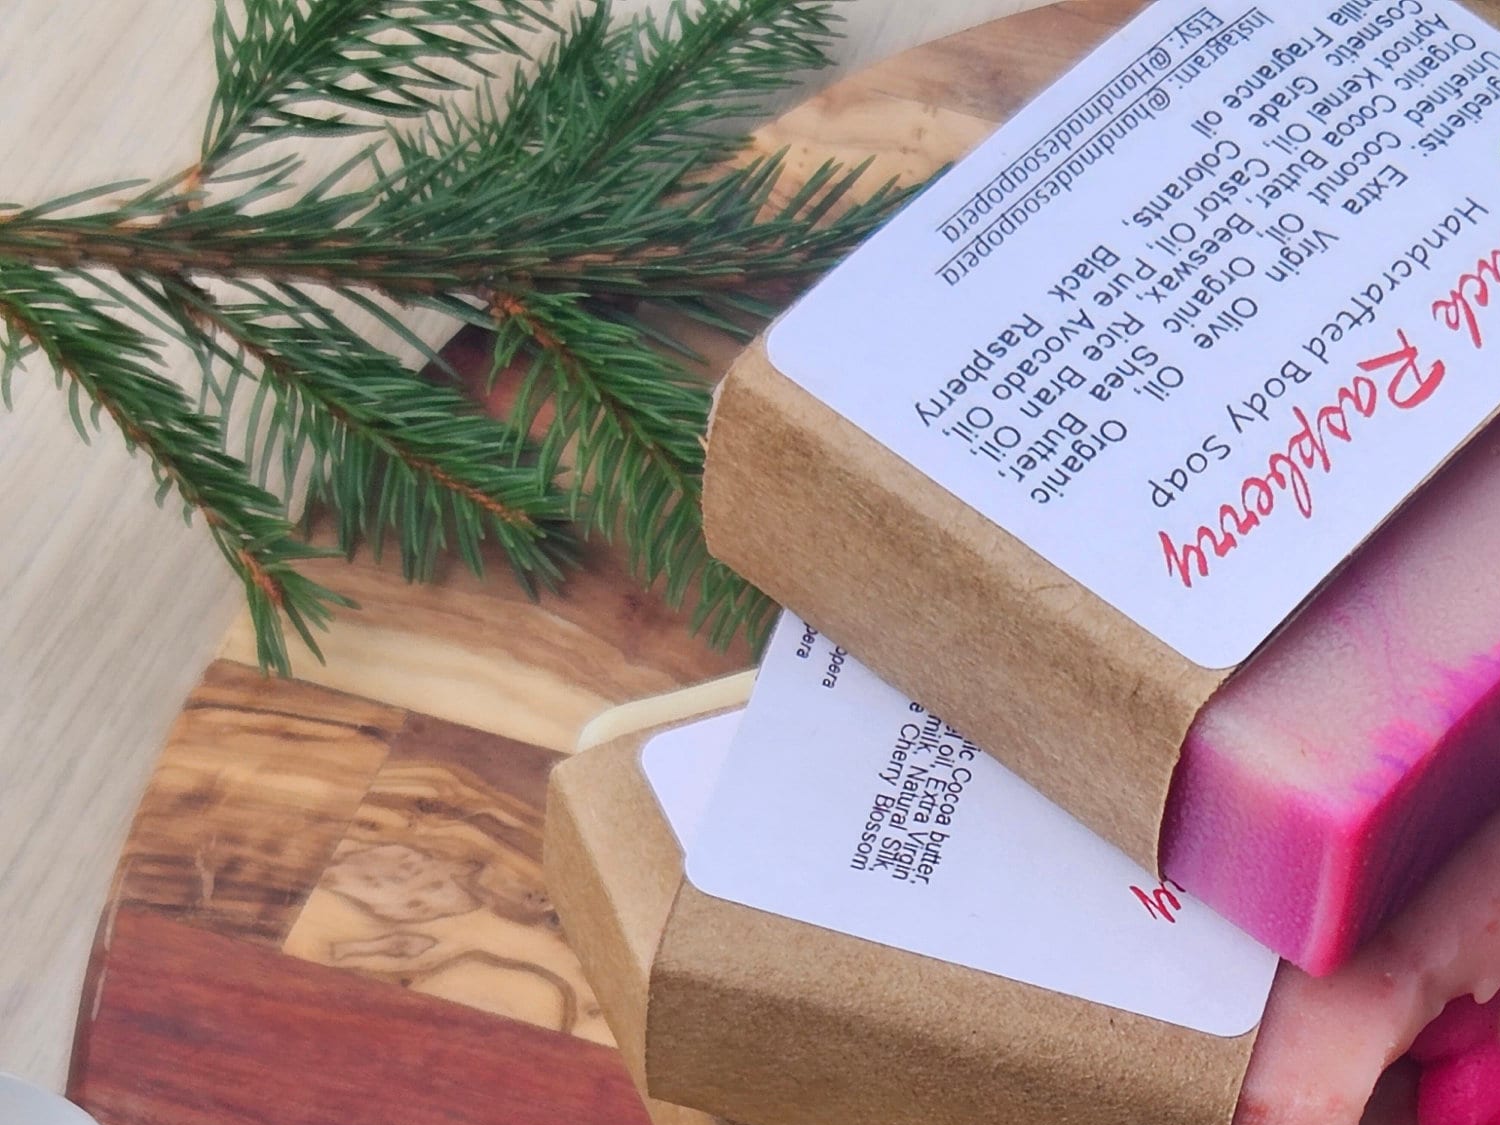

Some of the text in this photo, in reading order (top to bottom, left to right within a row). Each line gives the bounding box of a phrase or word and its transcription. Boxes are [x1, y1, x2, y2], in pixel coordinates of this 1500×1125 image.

[1170, 8, 1225, 50] Etsy:
[1175, 8, 1276, 90] Instagram:
[1222, 26, 1334, 110] Fragrance
[1190, 110, 1224, 140] oil
[1306, 130, 1402, 207] Coconut
[1340, 164, 1409, 215] Extra
[914, 0, 1424, 428] Cosmetic Grade Colorants, Black Raspberry
[941, 12, 1451, 444] Apricot Kernel Oil, Castor Oil, Pure Avocado Oil,
[1255, 212, 1305, 246] Oil,
[969, 33, 1477, 464] Organic Cocoa Butter, Beeswax, Rice Bran Oil,
[1264, 229, 1340, 283] Virgin
[1162, 256, 1256, 334] Organic
[1193, 296, 1259, 350] Olive
[1088, 344, 1159, 402] Shea
[1132, 365, 1185, 402] Oil,
[1147, 196, 1490, 508] Handcrafted Body Soap
[997, 411, 1089, 484] Butter,
[1030, 419, 1128, 504] Organic
[1157, 327, 1446, 589] Raspberry
[878, 723, 921, 786] Cherry
[888, 765, 929, 831] Natural
[913, 777, 948, 824] Extra
[935, 767, 972, 826] Cocoa
[850, 793, 896, 870] Blossom
[892, 831, 929, 881] Virgin
[909, 831, 950, 885] butter,
